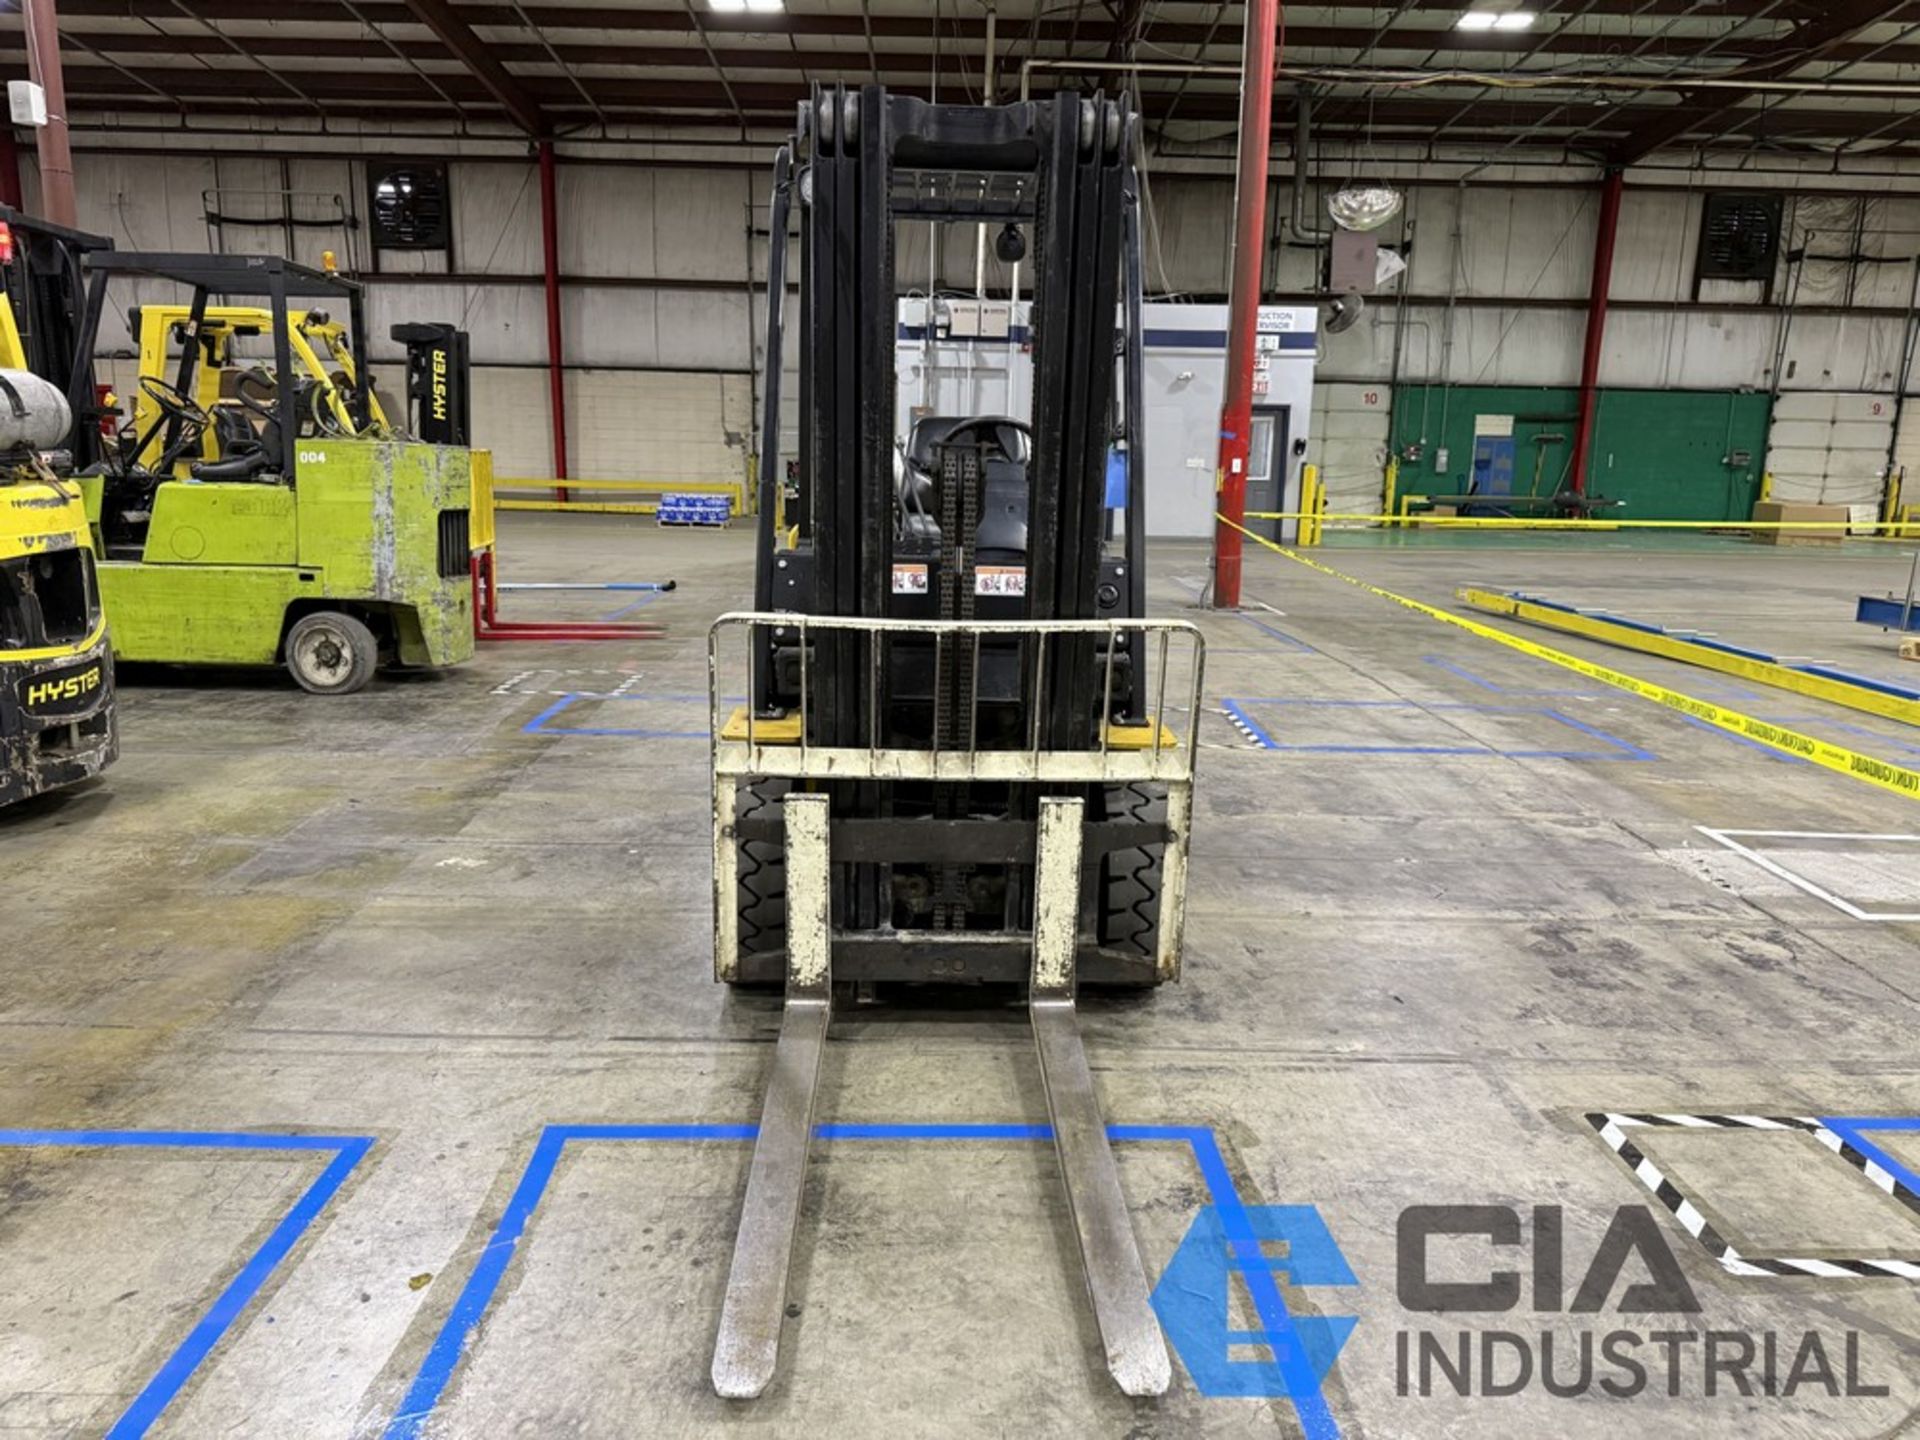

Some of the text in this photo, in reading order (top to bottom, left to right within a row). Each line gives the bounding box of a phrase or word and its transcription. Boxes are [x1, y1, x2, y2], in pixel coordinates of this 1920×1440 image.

[432, 349, 446, 421] HYSTER
[1364, 392, 1377, 405] 10
[1873, 402, 1881, 415] 9
[299, 450, 327, 464] 004
[28, 666, 100, 706] HYSTER
